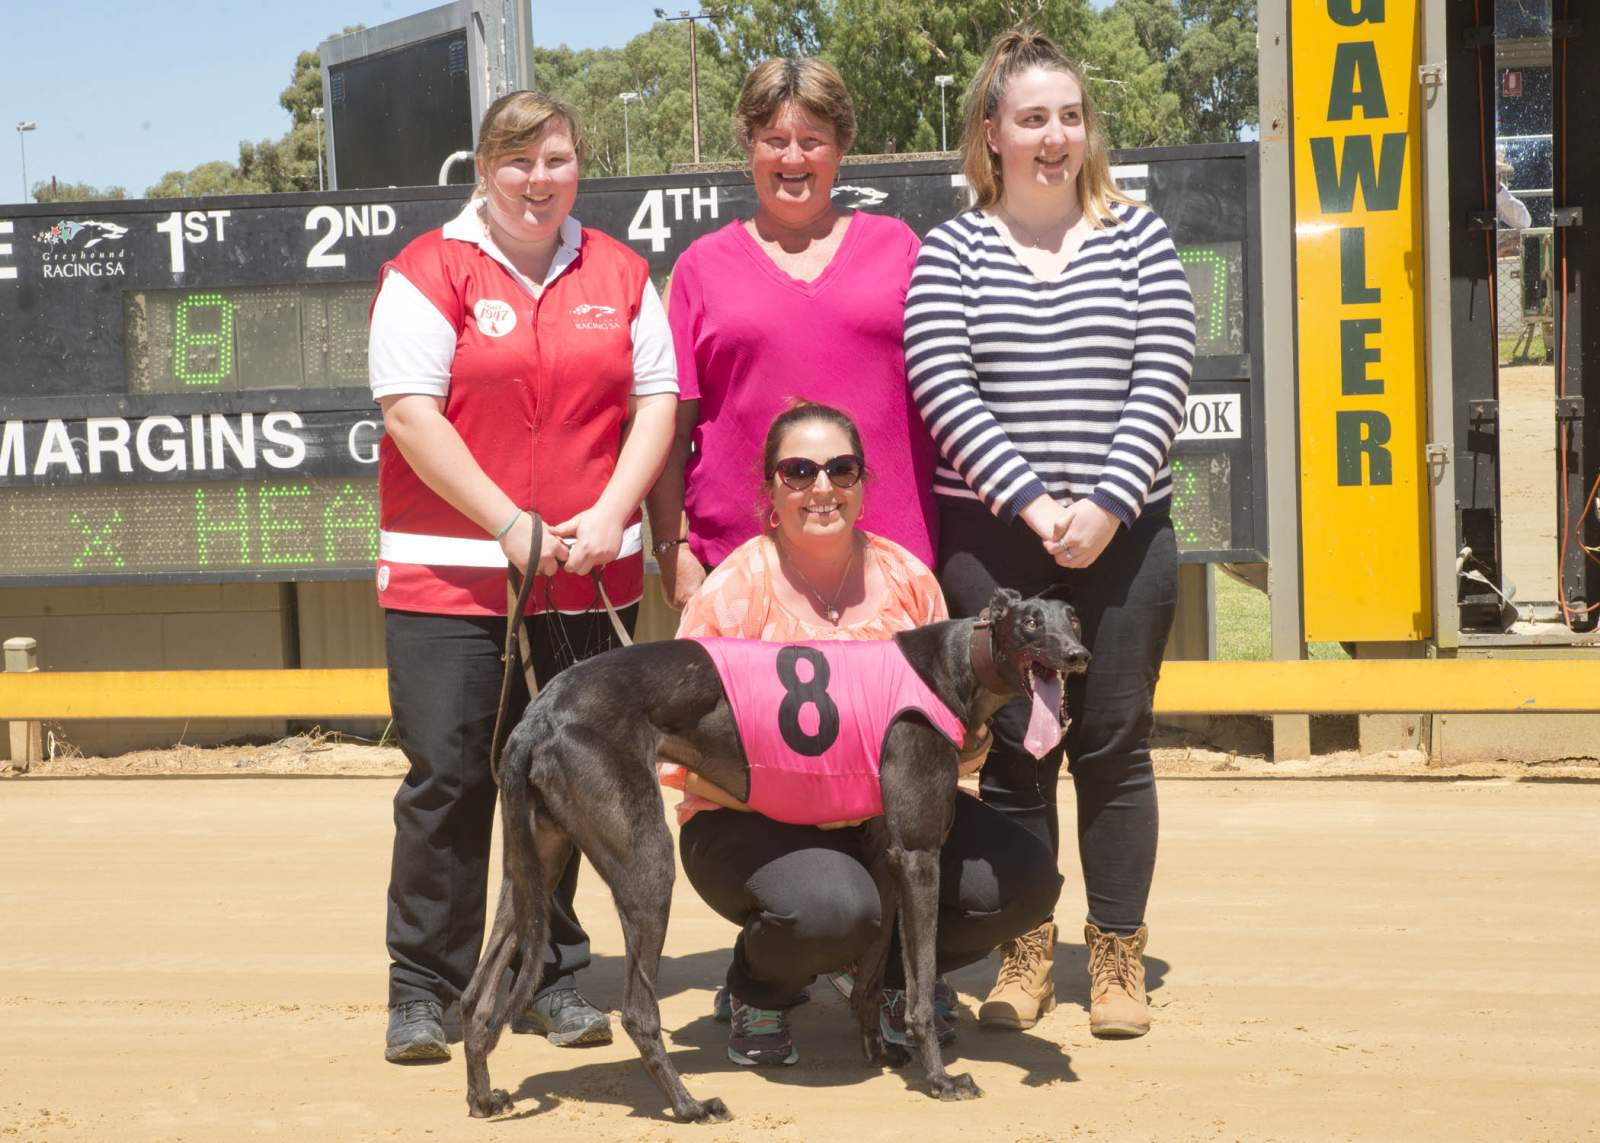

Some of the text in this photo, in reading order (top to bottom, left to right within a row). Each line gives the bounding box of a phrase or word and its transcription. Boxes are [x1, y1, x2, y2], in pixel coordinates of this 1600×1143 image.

[156, 210, 231, 273] 1ST
[304, 204, 397, 268] 2ND
[628, 187, 719, 252] 4TH
[43, 262, 125, 278] RACING SA
[174, 293, 234, 385] 8
[776, 645, 839, 757] 8
